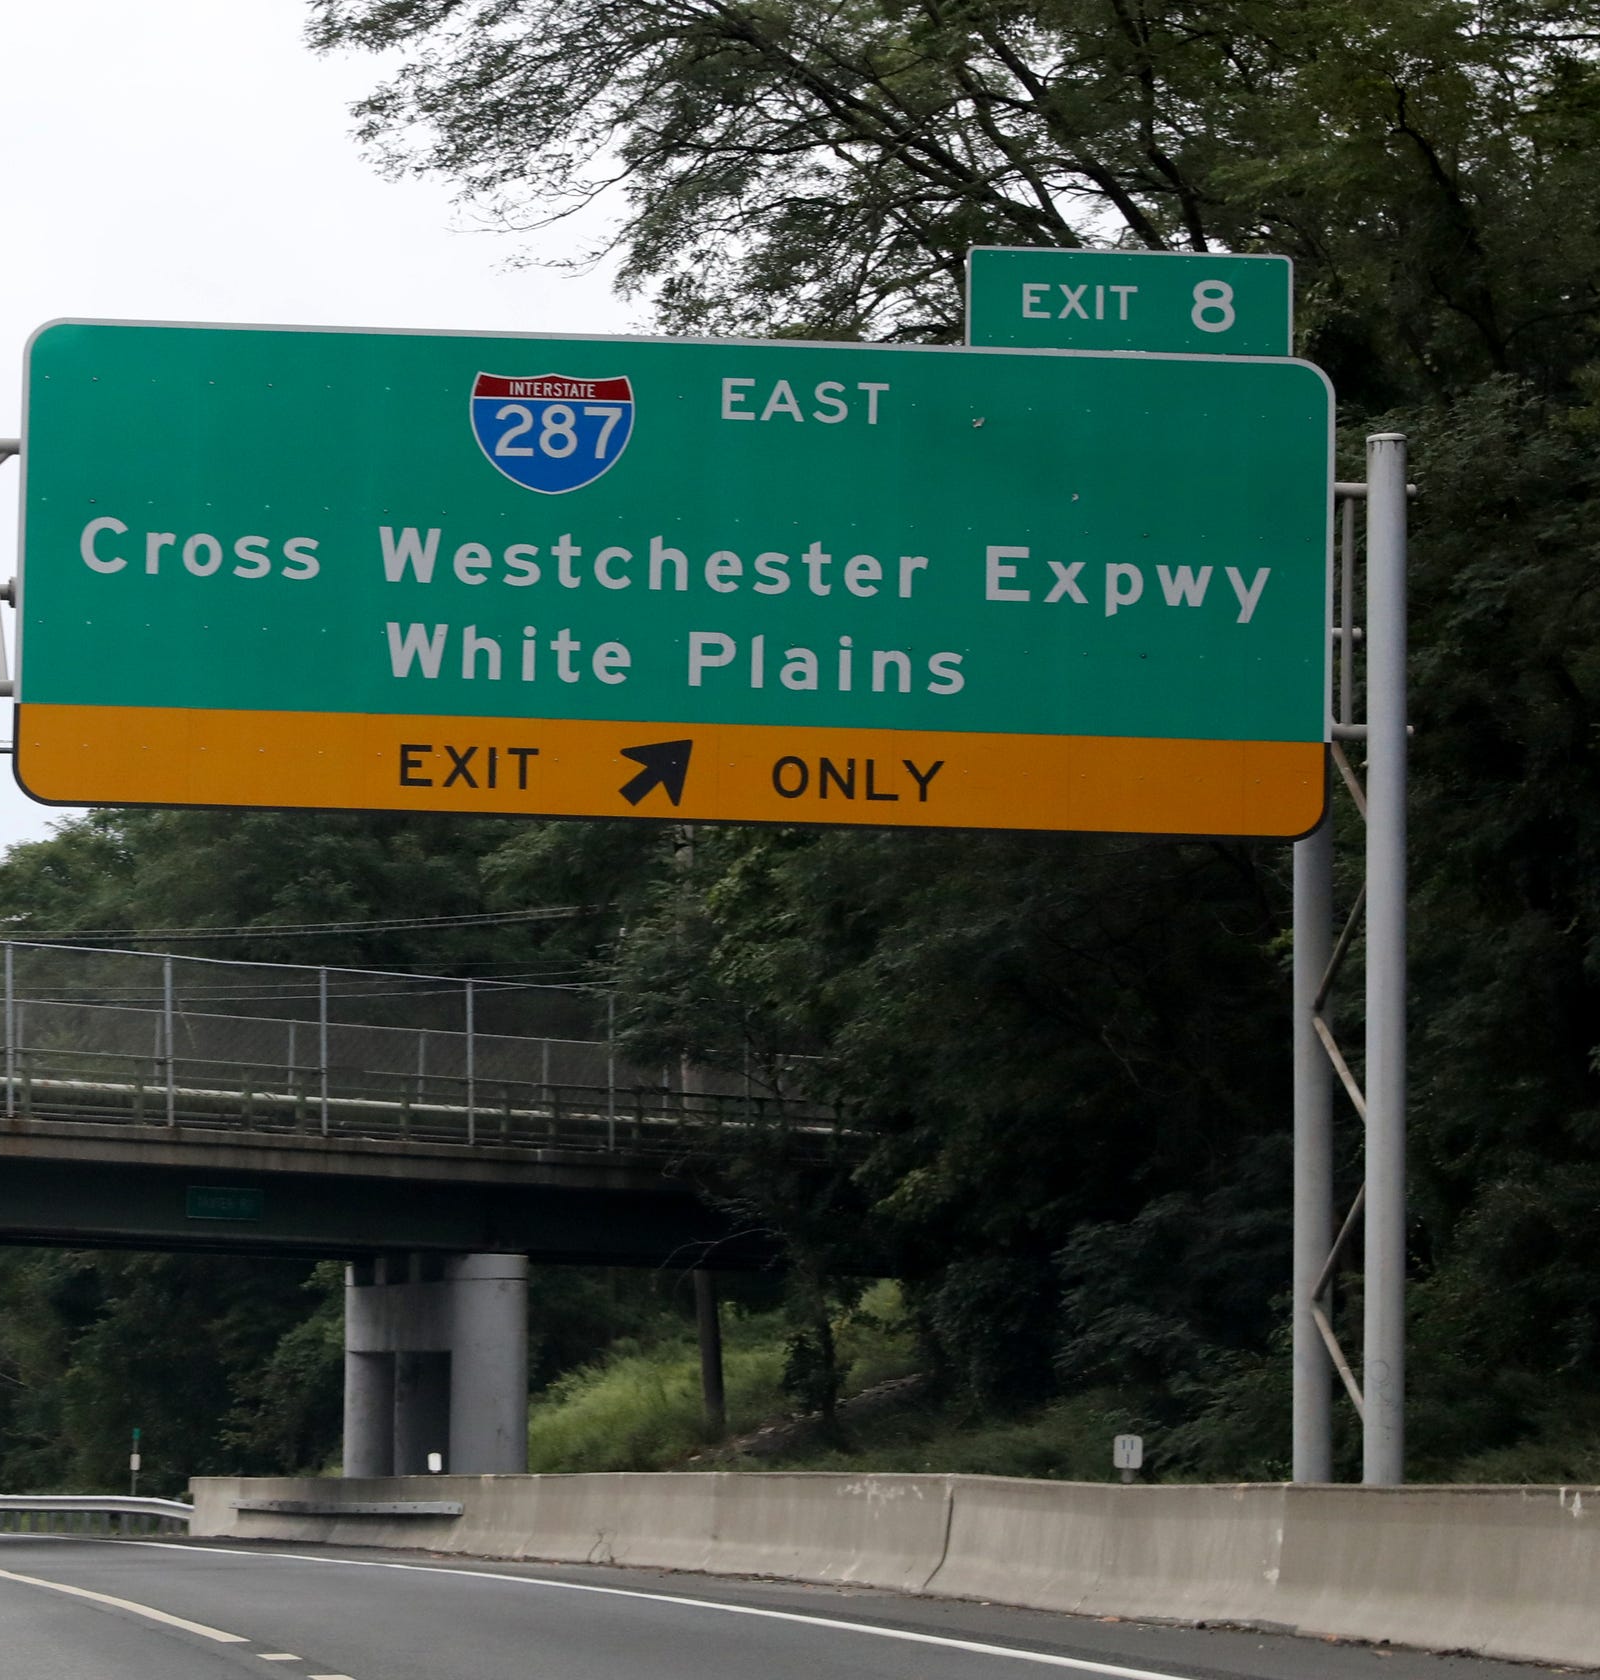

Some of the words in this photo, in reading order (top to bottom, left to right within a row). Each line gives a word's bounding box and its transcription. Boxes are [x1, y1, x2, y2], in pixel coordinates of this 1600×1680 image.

[1022, 283, 1138, 321] EXIT
[1191, 280, 1236, 333] 8
[508, 379, 596, 399] INTERSTATE
[721, 377, 890, 425] EAST
[494, 403, 622, 460] 287
[80, 516, 320, 580] Cross
[379, 526, 929, 598] Westchester
[985, 545, 1271, 624] Expwy
[386, 621, 632, 685] White
[687, 631, 966, 695] Plains
[399, 743, 541, 791] EXIT
[770, 755, 946, 803] ONLY
